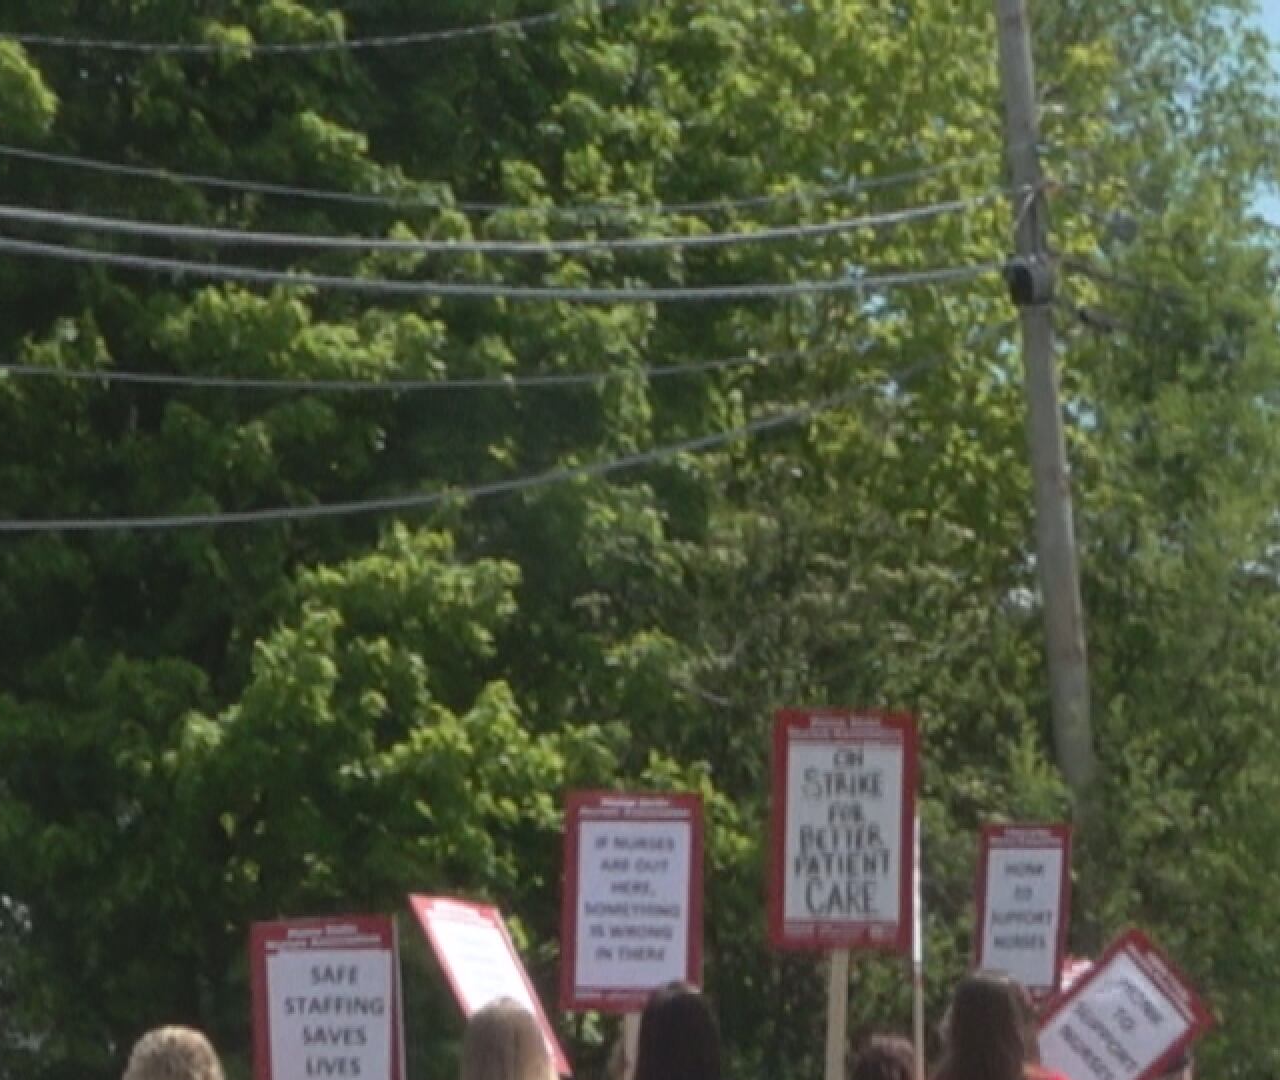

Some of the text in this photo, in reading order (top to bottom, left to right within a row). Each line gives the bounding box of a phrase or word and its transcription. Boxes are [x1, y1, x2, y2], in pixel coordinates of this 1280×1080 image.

[801, 766, 883, 799] STRIKE
[634, 858, 668, 873] OUT
[794, 850, 891, 879] PATIENT
[805, 879, 879, 914] CARE
[310, 964, 359, 985] SAFE
[284, 997, 386, 1017] STAFFING
[303, 1025, 368, 1047] SAVES
[305, 1056, 361, 1077] LIVES
